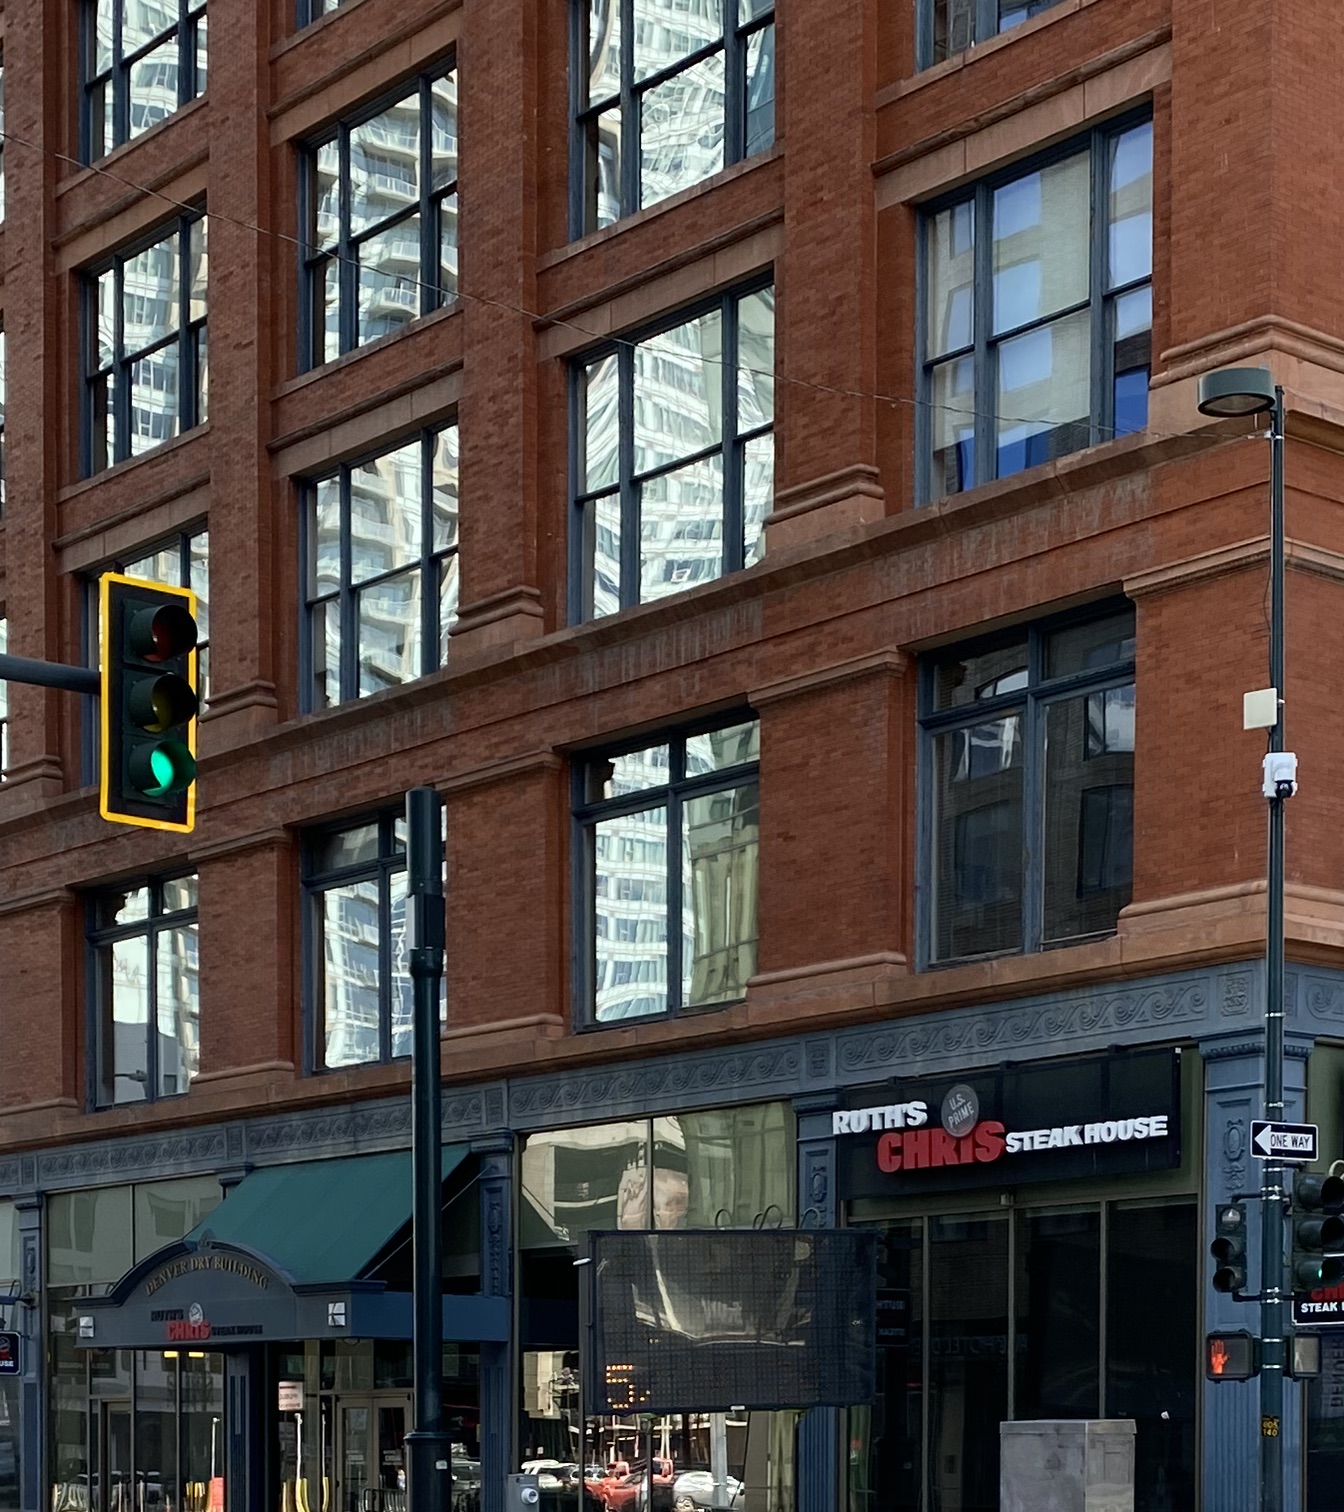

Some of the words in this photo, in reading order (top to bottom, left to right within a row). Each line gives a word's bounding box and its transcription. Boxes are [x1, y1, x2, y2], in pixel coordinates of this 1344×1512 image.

[833, 1101, 928, 1135] RUTH'S
[948, 1101, 975, 1129] PRIME
[876, 1120, 1006, 1173] CHRIS
[1271, 1134, 1288, 1148] ONE
[1291, 1135, 1311, 1149] WAY
[146, 1261, 189, 1297] DENVER
[190, 1256, 212, 1271] DRY
[214, 1256, 269, 1290] BUILDING
[1301, 1302, 1338, 1313] STEAK
[166, 1320, 211, 1341] CHRIS
